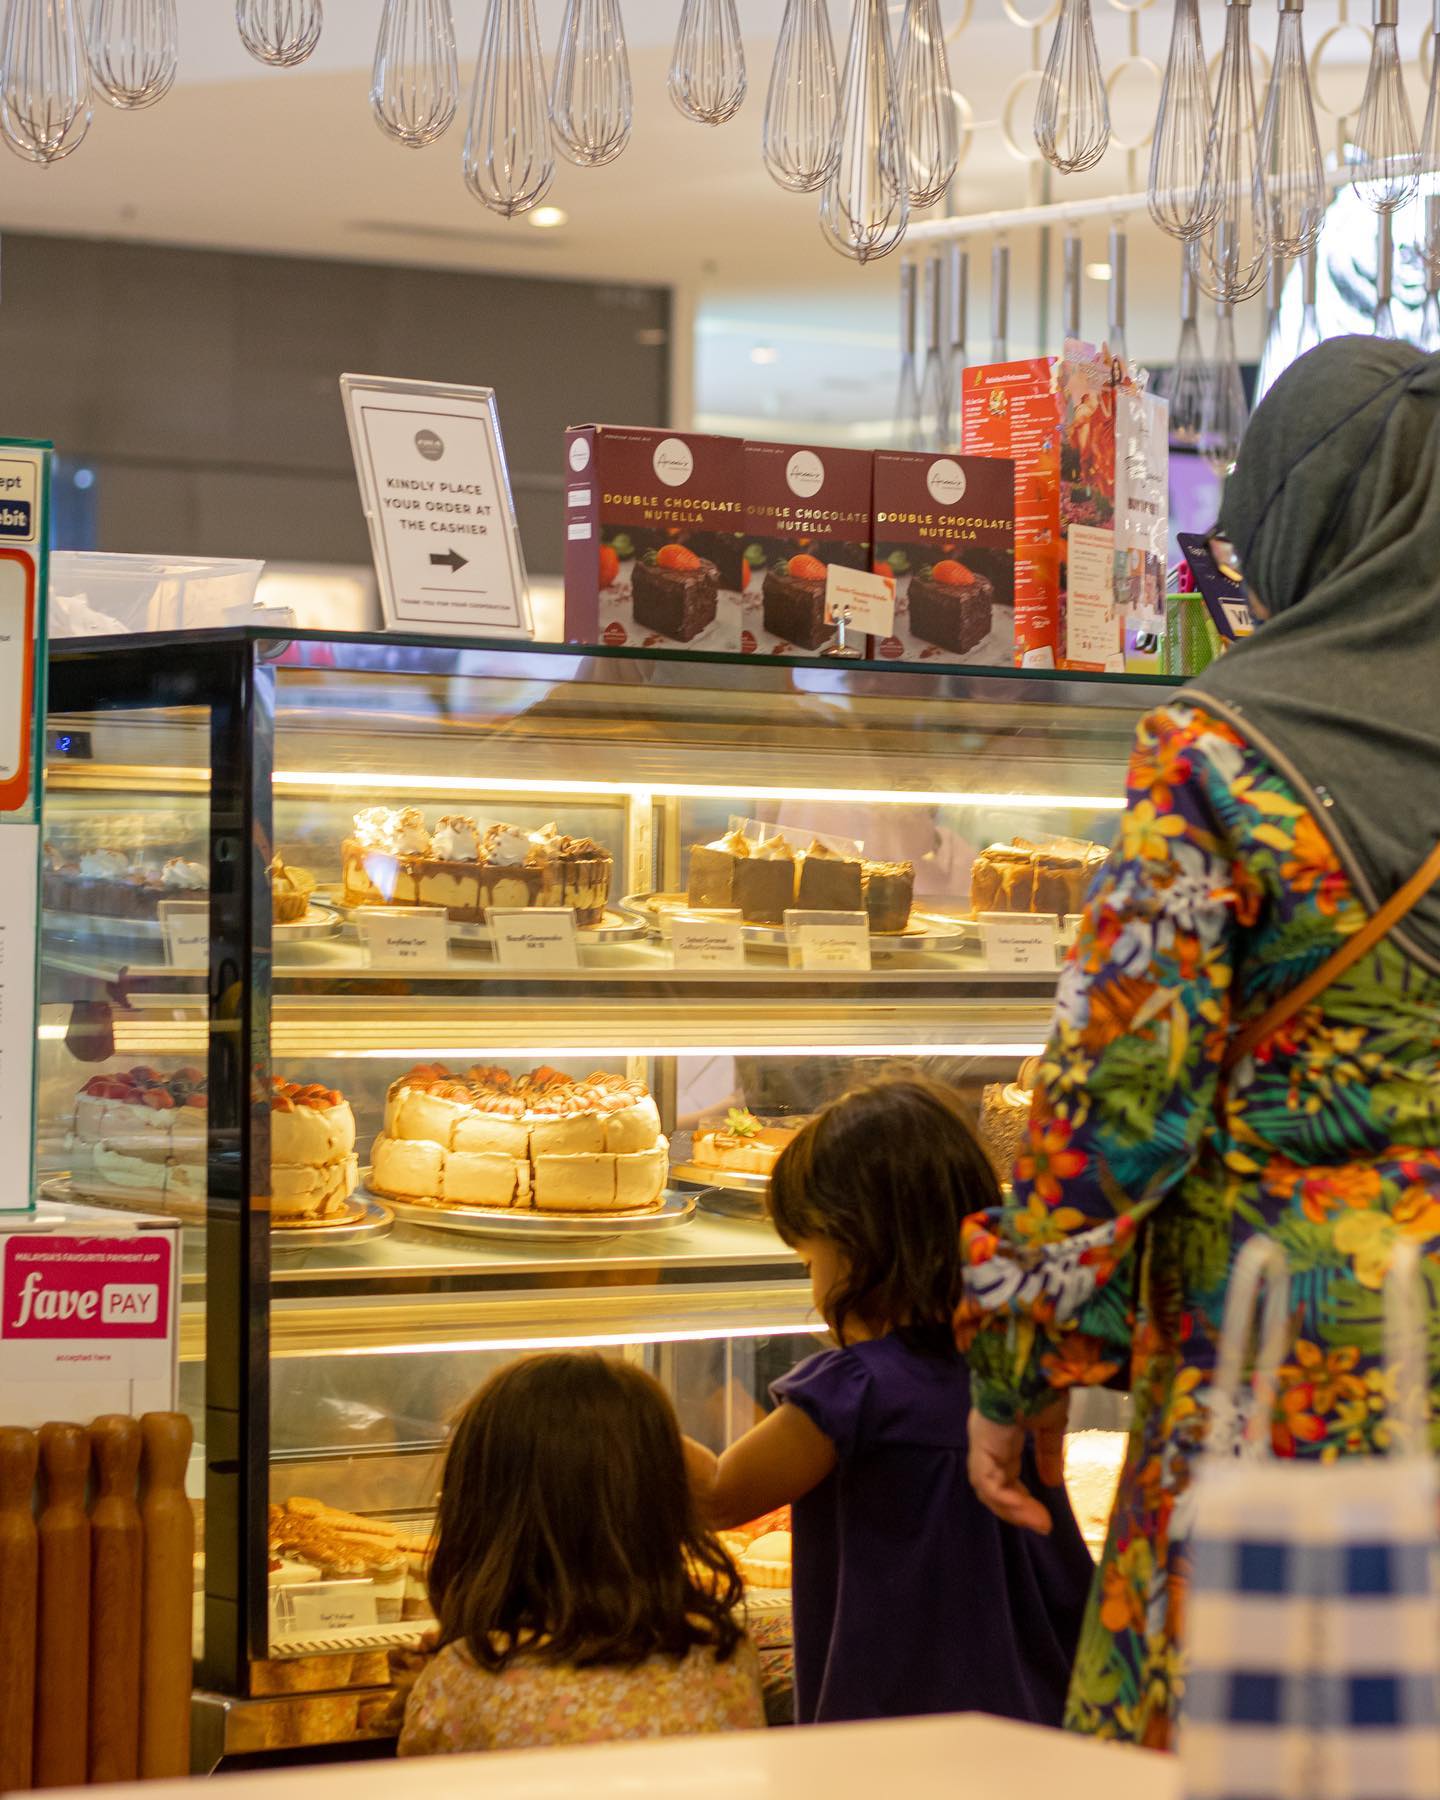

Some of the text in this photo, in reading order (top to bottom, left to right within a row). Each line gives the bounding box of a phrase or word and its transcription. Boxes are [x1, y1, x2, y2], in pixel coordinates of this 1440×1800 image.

[386, 478, 482, 495] KINDLY PLACE
[383, 498, 491, 516] YOUR ORDER AT
[603, 493, 658, 507] DOUBLE
[663, 498, 742, 513] CHOCOLATE
[0, 508, 26, 526] bit
[644, 510, 704, 523] NUTELLA
[747, 505, 869, 524] OUBLE CHOCOLATE
[877, 512, 933, 525] DOUBLE
[938, 515, 1013, 530] CHOCOLATE
[400, 519, 487, 536] THE CASHIER
[776, 521, 833, 534] NUTELLA
[919, 527, 977, 540] NUTELLA
[12, 1272, 152, 1328] fave PAY
[55, 1353, 111, 1362] accepted here
